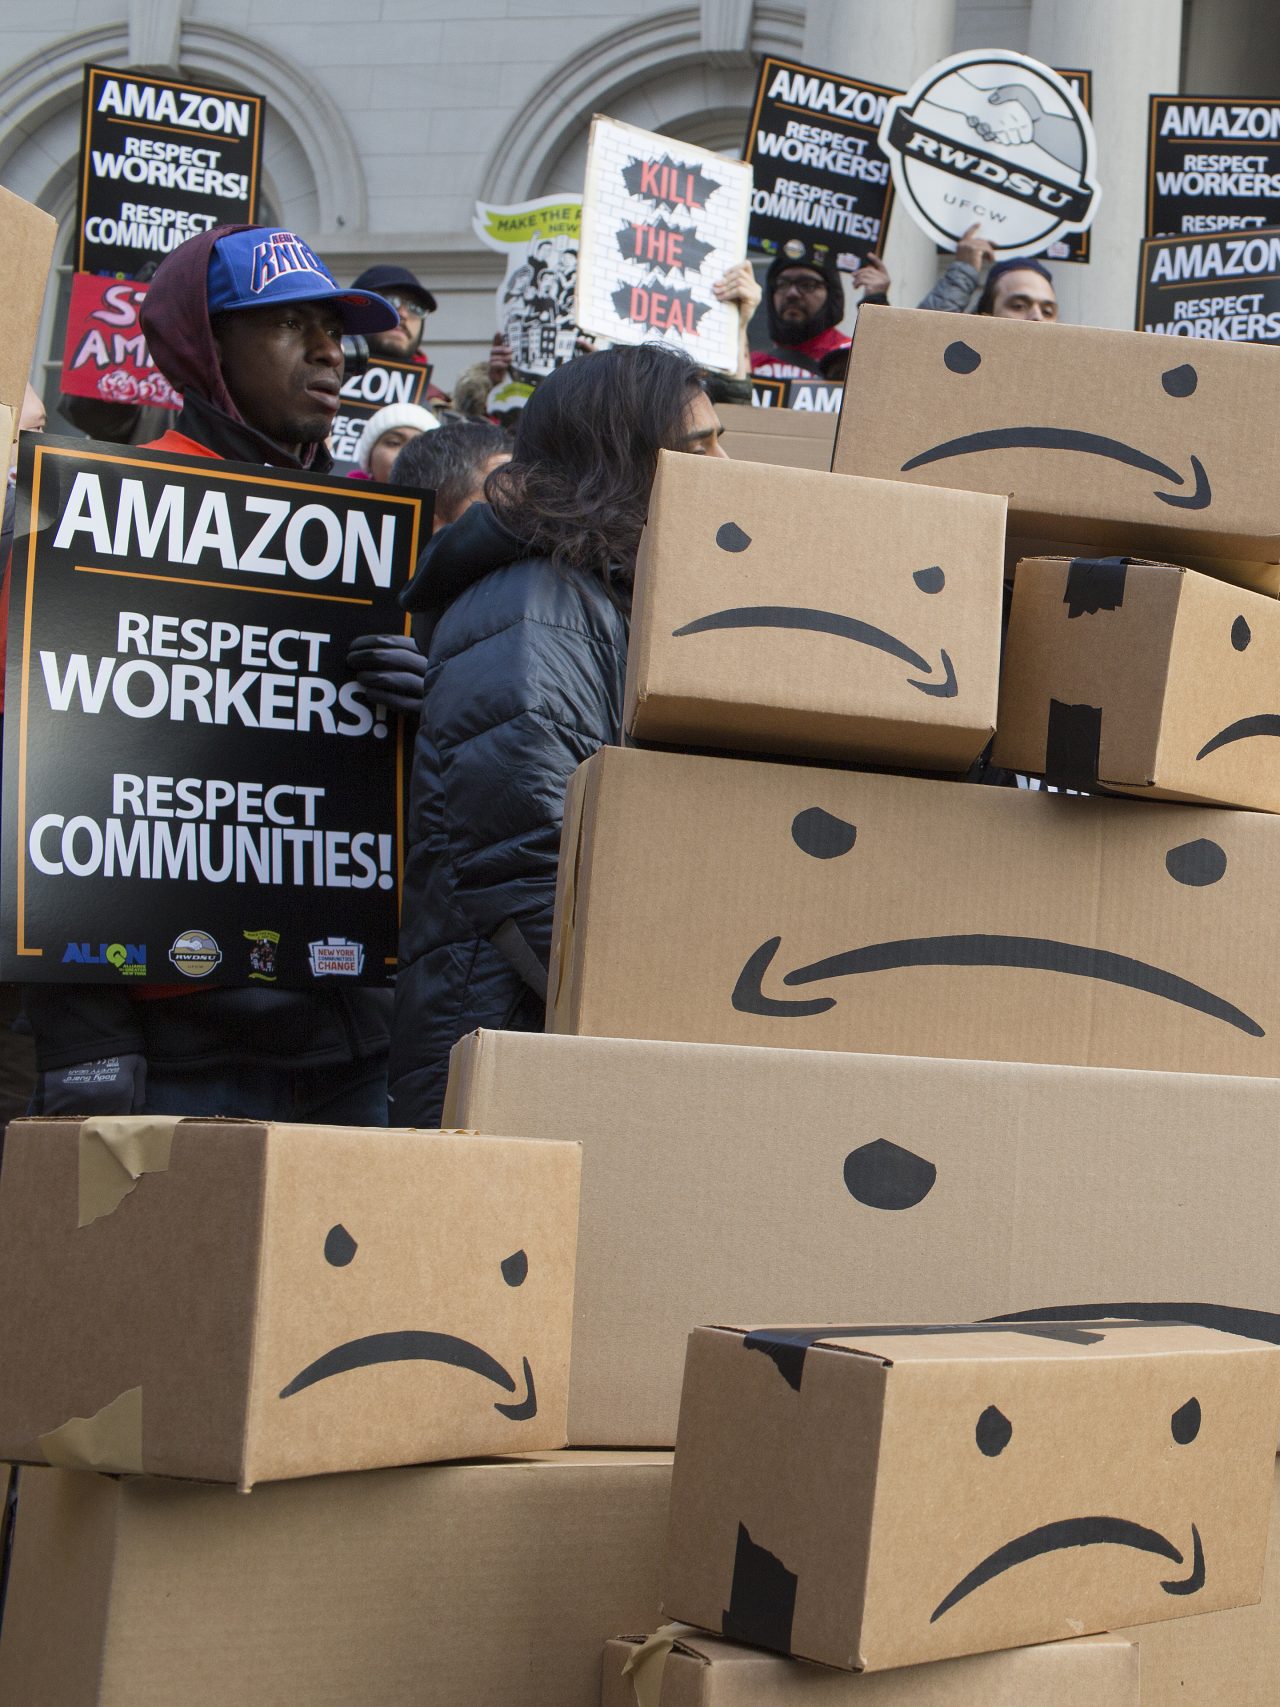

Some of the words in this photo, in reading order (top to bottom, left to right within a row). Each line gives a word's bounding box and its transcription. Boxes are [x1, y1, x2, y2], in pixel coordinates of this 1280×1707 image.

[98, 80, 249, 137] AMAZON
[124, 136, 221, 169] RESPECT
[757, 130, 890, 186] WORKERS!
[786, 121, 869, 155] RESPECT
[92, 151, 249, 200] WORKERS!
[906, 132, 1073, 208] RWDSU
[1183, 154, 1269, 173] RESPECT
[639, 161, 701, 208] KILL
[774, 177, 859, 211] RESPECT
[121, 202, 218, 233] RESPECT
[497, 215, 537, 231] MAKE
[540, 208, 572, 222] THE
[549, 223, 577, 232] NEW
[944, 193, 1008, 223] UFCW
[85, 217, 200, 253] COMMUN
[631, 223, 685, 267] THE
[630, 287, 701, 336] DEAL
[1174, 294, 1265, 320] RESPECT
[53, 473, 396, 588] AMAZON
[117, 611, 331, 672] RESPECT
[39, 651, 389, 738] WORKERS!
[113, 773, 325, 826] RESPECT
[29, 814, 394, 891] COMMUNITIES!
[318, 962, 355, 971] CHANGE
[337, 949, 354, 957] YORK
